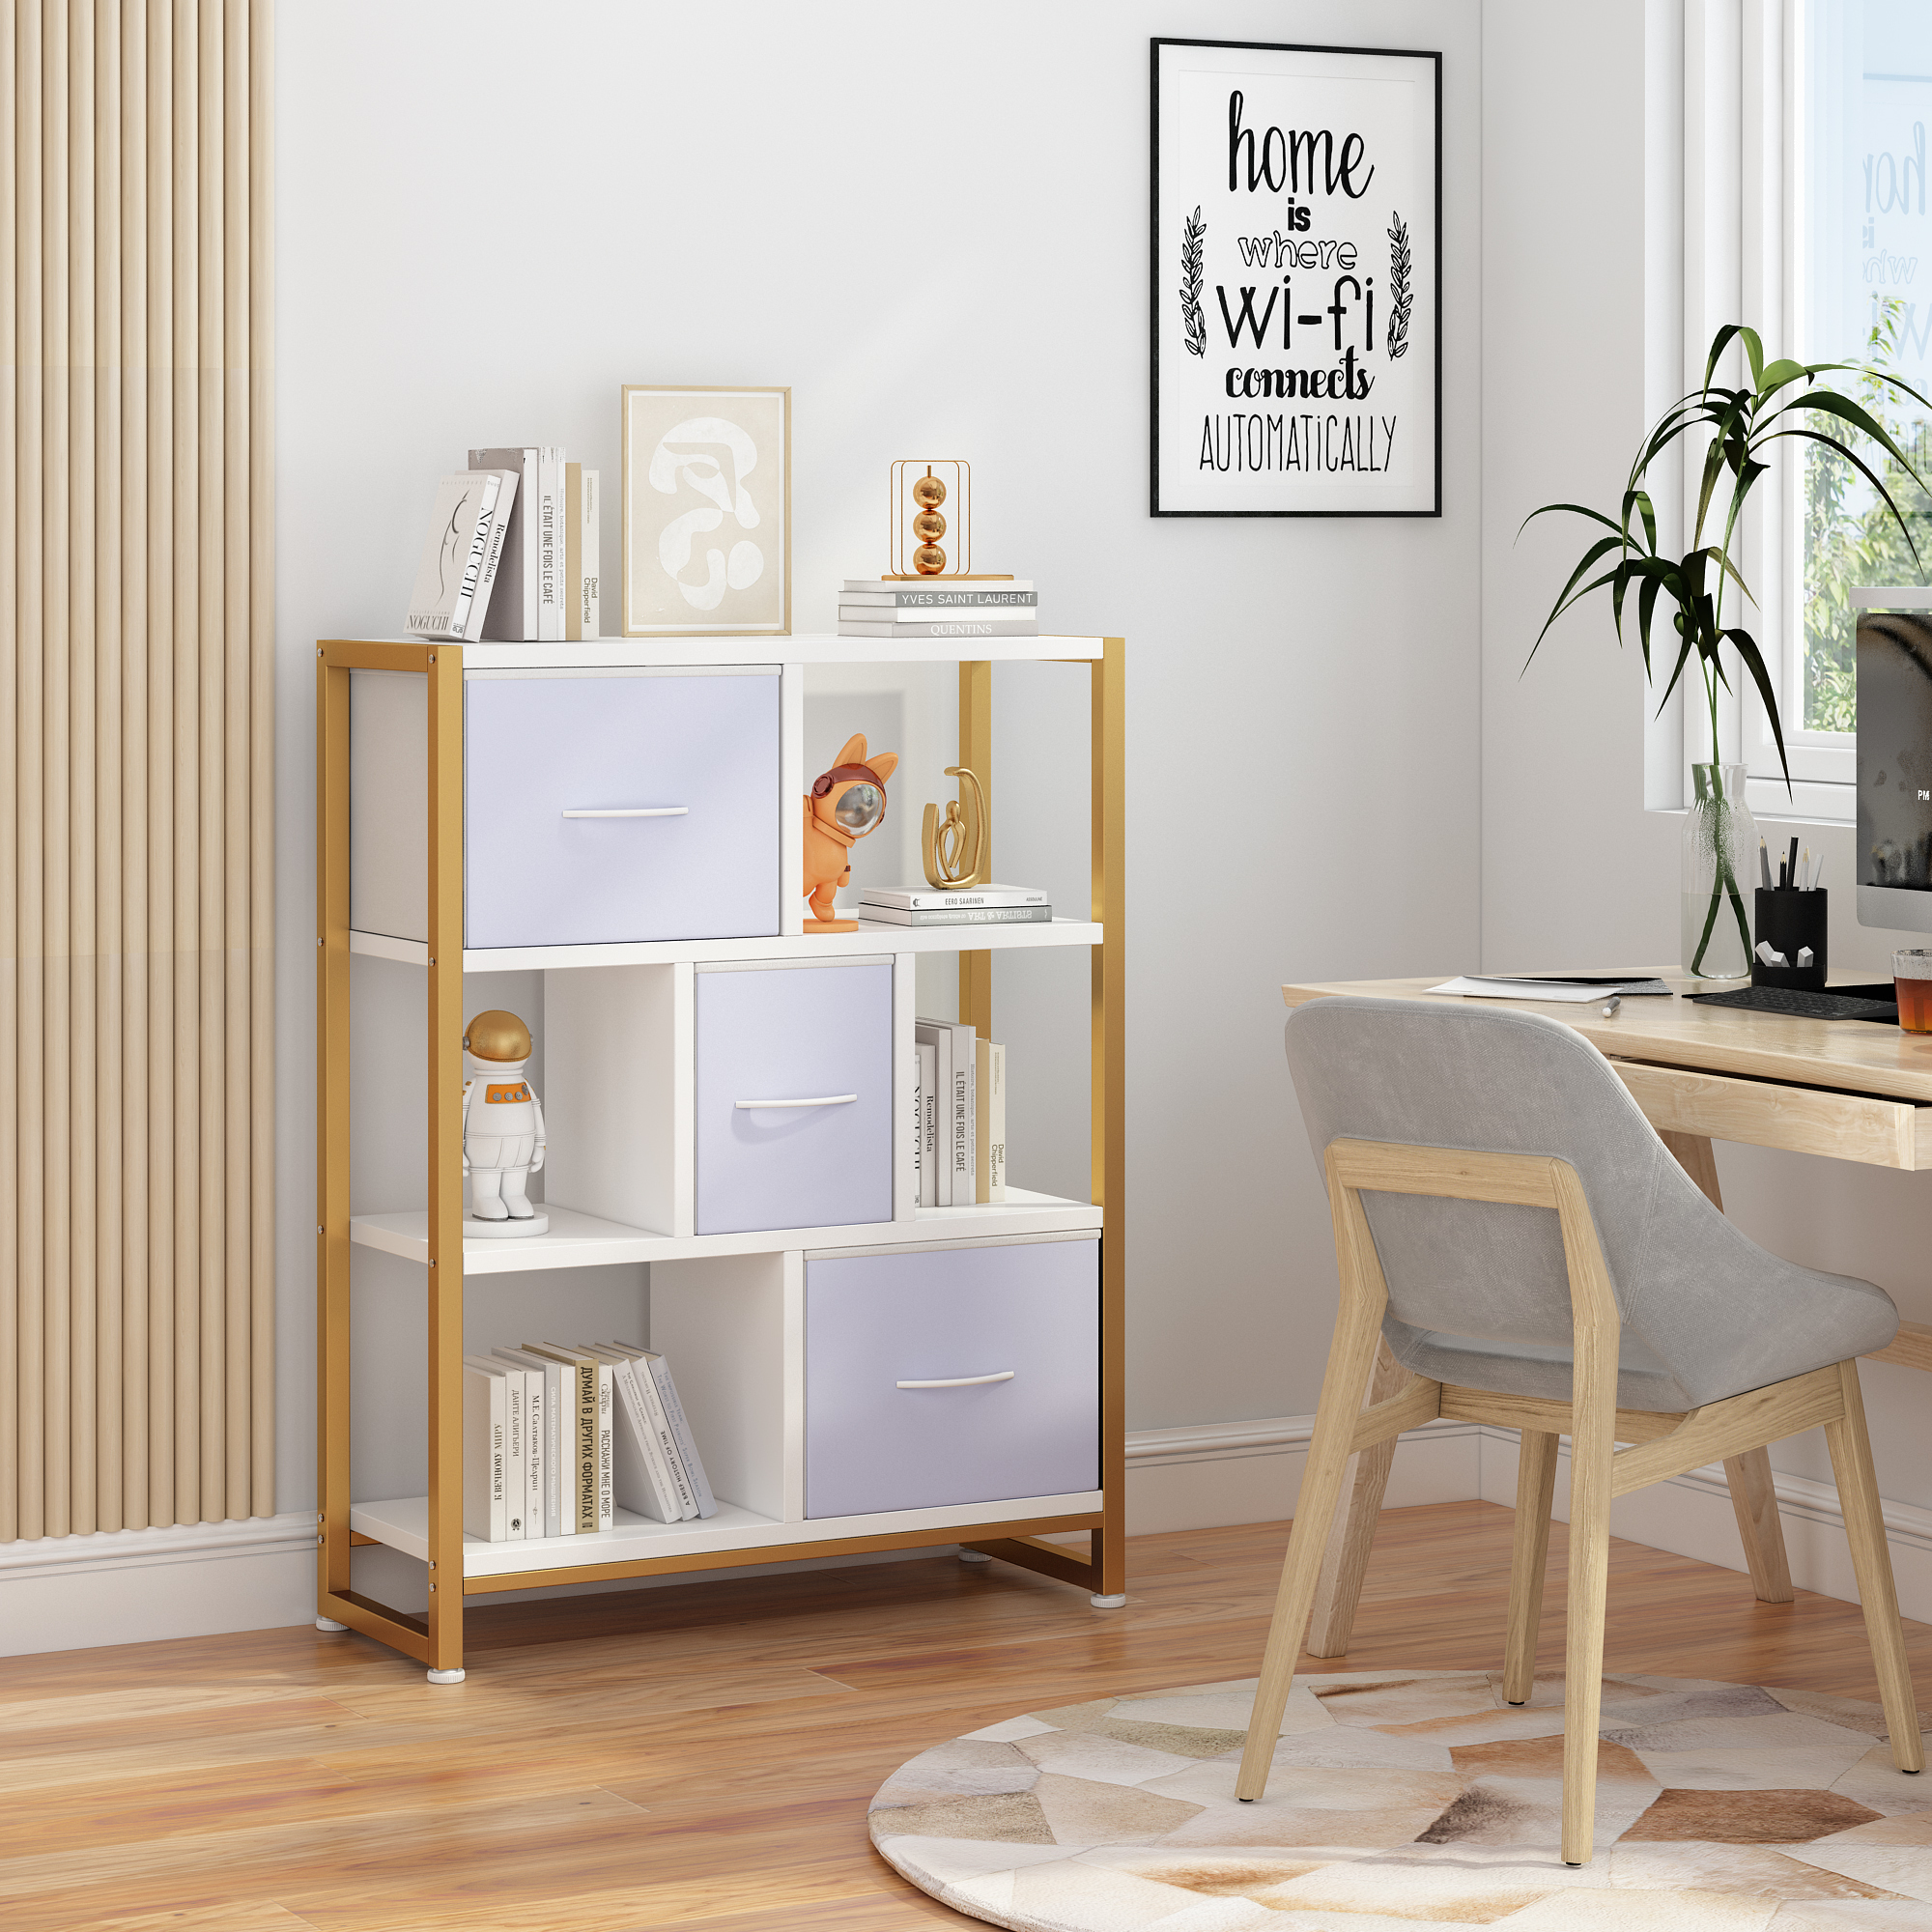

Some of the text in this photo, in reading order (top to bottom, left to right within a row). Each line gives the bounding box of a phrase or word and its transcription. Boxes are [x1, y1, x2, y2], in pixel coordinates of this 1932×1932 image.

[1229, 90, 1376, 199] home
[1287, 197, 1312, 232] is
[1236, 230, 1358, 270] where
[1226, 345, 1376, 400] connects
[461, 507, 493, 598] NOGUCHI
[484, 524, 505, 583] Remodelista
[543, 496, 554, 605] IL ÉTAIT UNE FOIS LE CAFÉ
[582, 578, 591, 624] Chipperfield
[902, 593, 1034, 605] YVES SAINT LAURENT
[407, 614, 449, 630] NOGUCHI
[930, 624, 992, 636] QUENTINS
[945, 897, 958, 906] EERO
[956, 1081, 966, 1101] ÉTAIT
[956, 1141, 964, 1150] LE
[956, 1151, 966, 1173] CAFÉ
[581, 1367, 595, 1404] ДУМАЙ
[581, 1418, 593, 1459] ДРУГИХ
[601, 1430, 611, 1470] РАССКАЖИ
[660, 1430, 668, 1445] TIME
[601, 1471, 611, 1489] МНЕ
[669, 1457, 682, 1483] HISTORY
[582, 1462, 593, 1519] ФОРМАТАХ
[678, 1484, 689, 1500] BRIEF
[601, 1497, 611, 1519] МОРЕ
